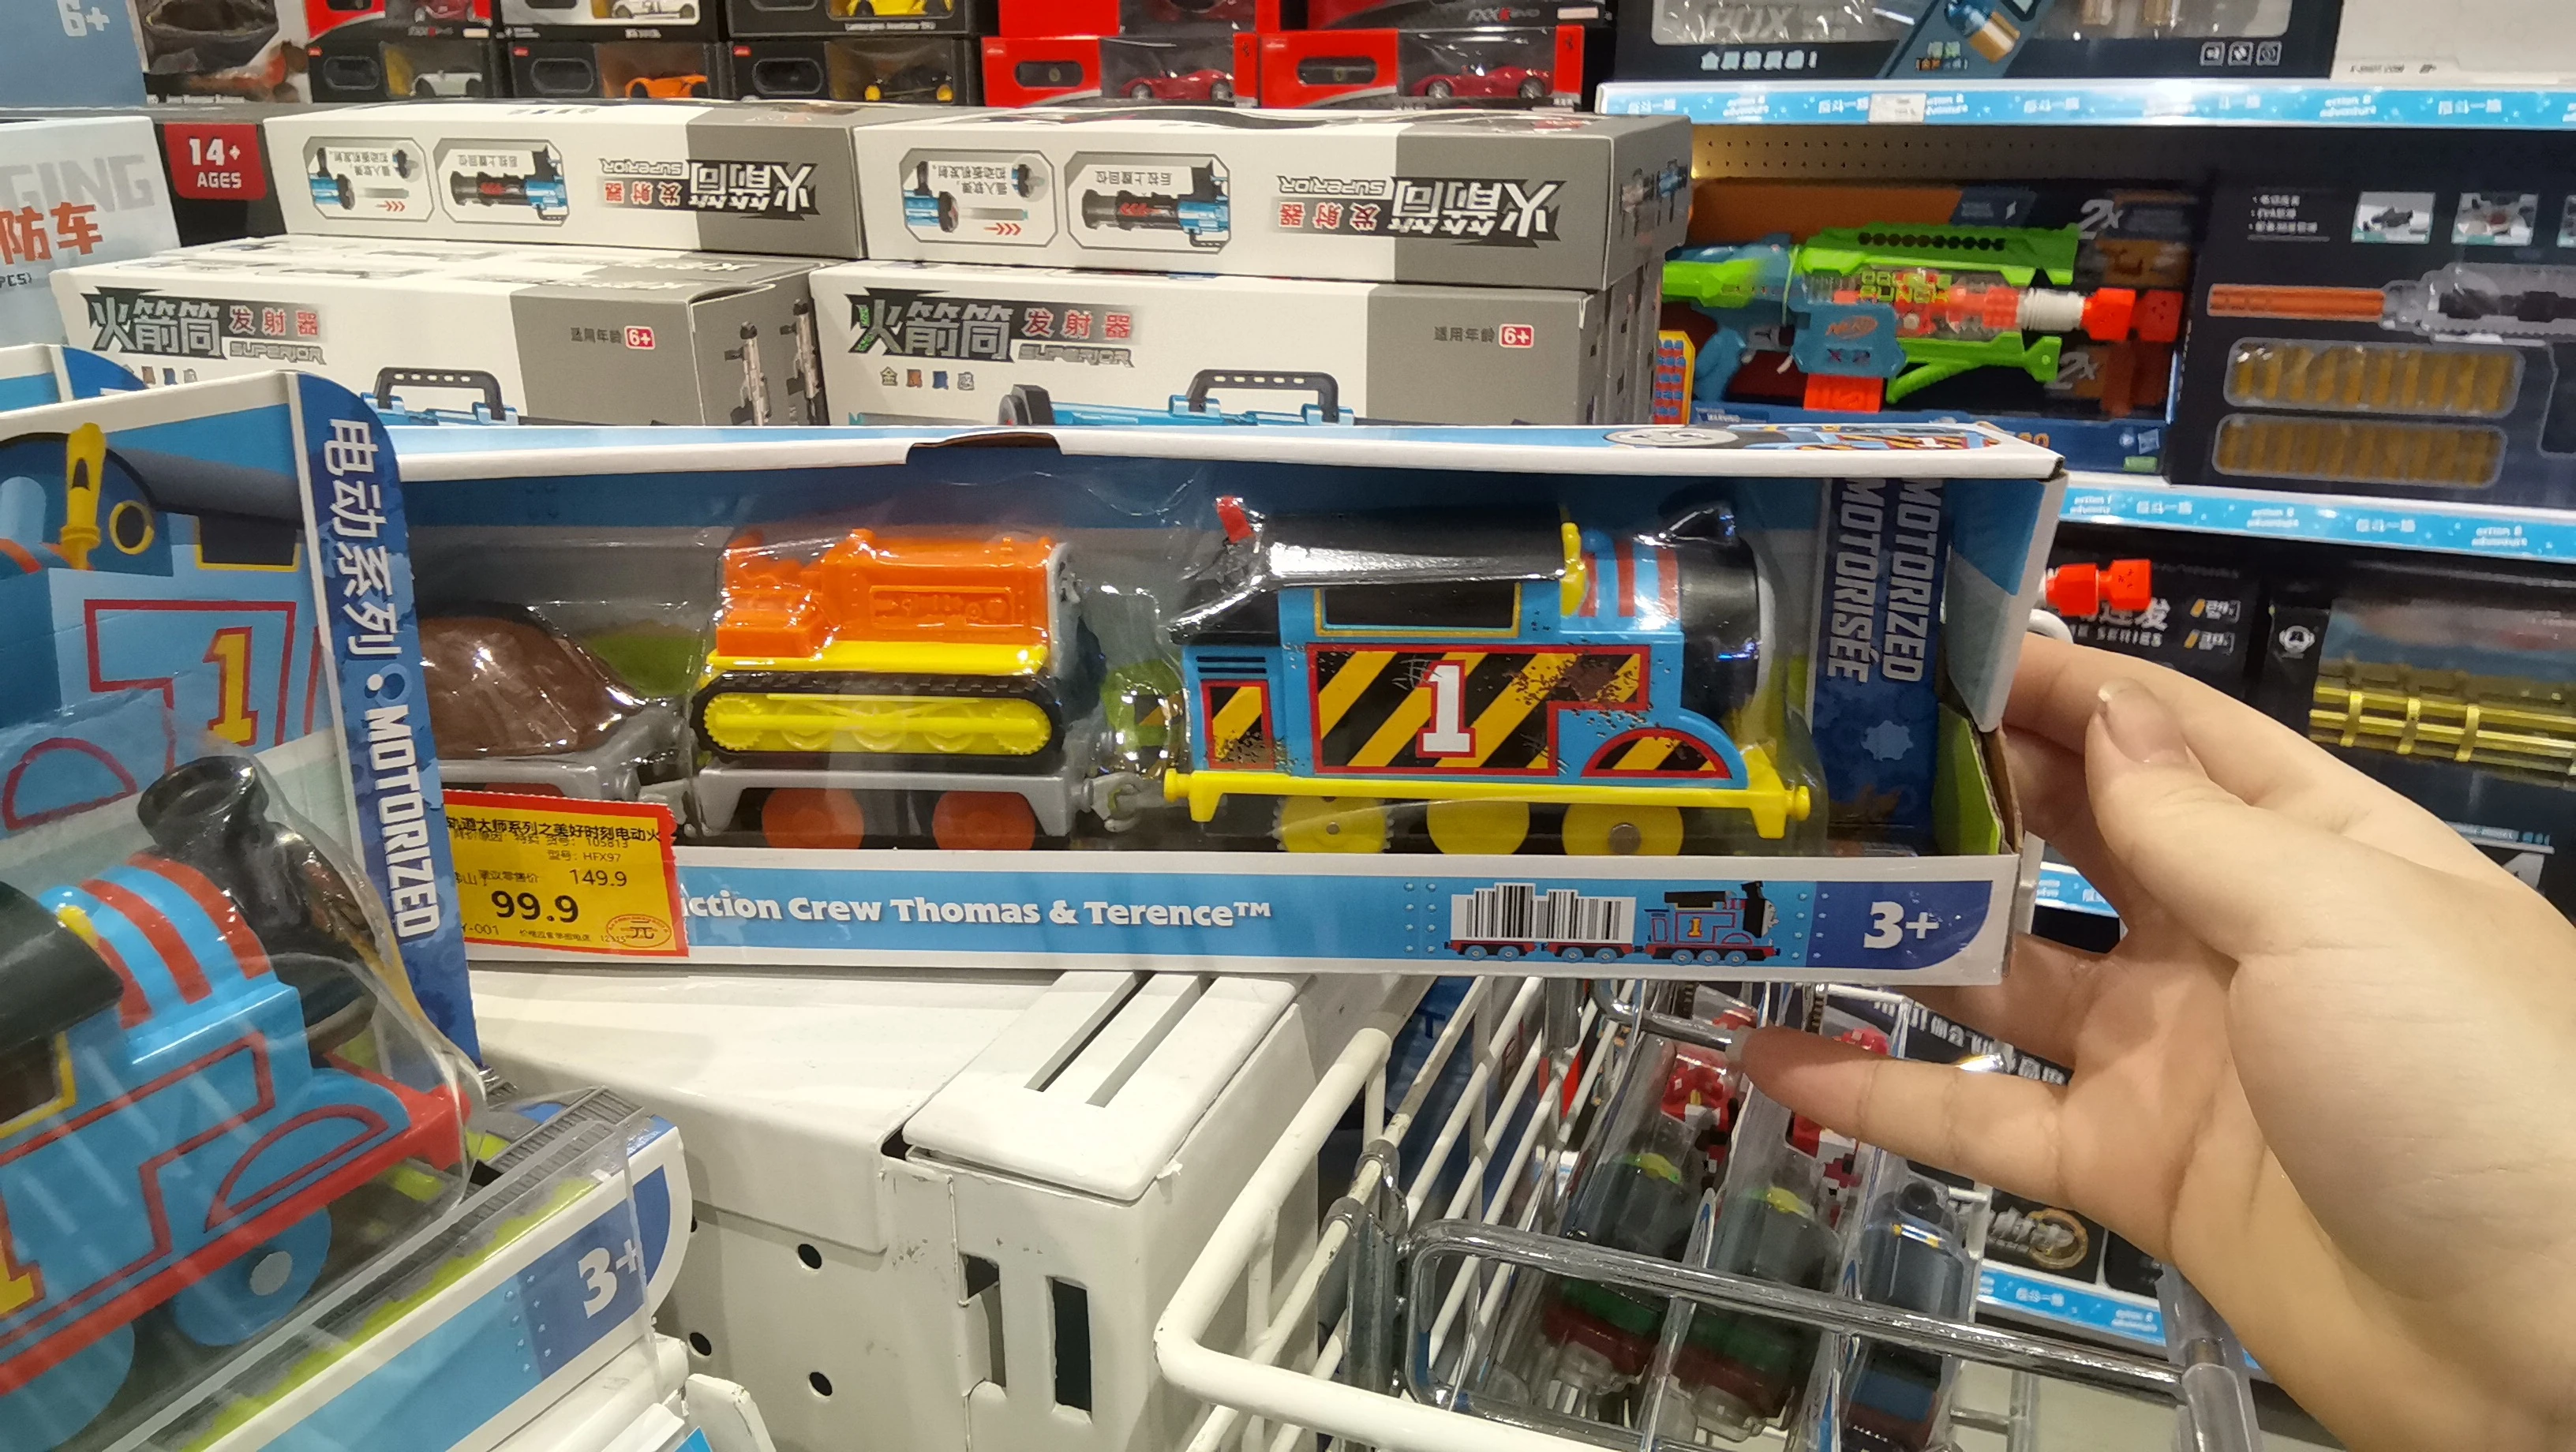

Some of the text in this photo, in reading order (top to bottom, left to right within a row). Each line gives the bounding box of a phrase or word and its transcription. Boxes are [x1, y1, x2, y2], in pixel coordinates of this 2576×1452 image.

[58, 0, 110, 37] 6+
[189, 137, 241, 167] 14+
[197, 171, 242, 189] AGES
[1276, 175, 1387, 196] SUPERIOR
[1277, 200, 1380, 232] 发射器
[92, 296, 320, 357] 火箭筒 发射器
[628, 328, 652, 347] 6+
[849, 298, 1133, 360] 火箭筒 发射器
[1503, 327, 1530, 345] 6+
[323, 417, 403, 656] 电动系列
[1826, 478, 1887, 683] MOTORISÉE
[1881, 478, 1944, 682] MOTORIZED
[203, 626, 258, 747] 1
[1419, 661, 1475, 758] 1
[363, 703, 442, 940] MOTORIZED
[569, 868, 627, 887] 149.9
[491, 890, 578, 924] 99.9
[788, 897, 882, 922] Crew
[889, 896, 1041, 924] Thomas
[1050, 899, 1077, 925] &
[1863, 900, 1940, 949] 3+
[577, 1237, 642, 1319] 3+
